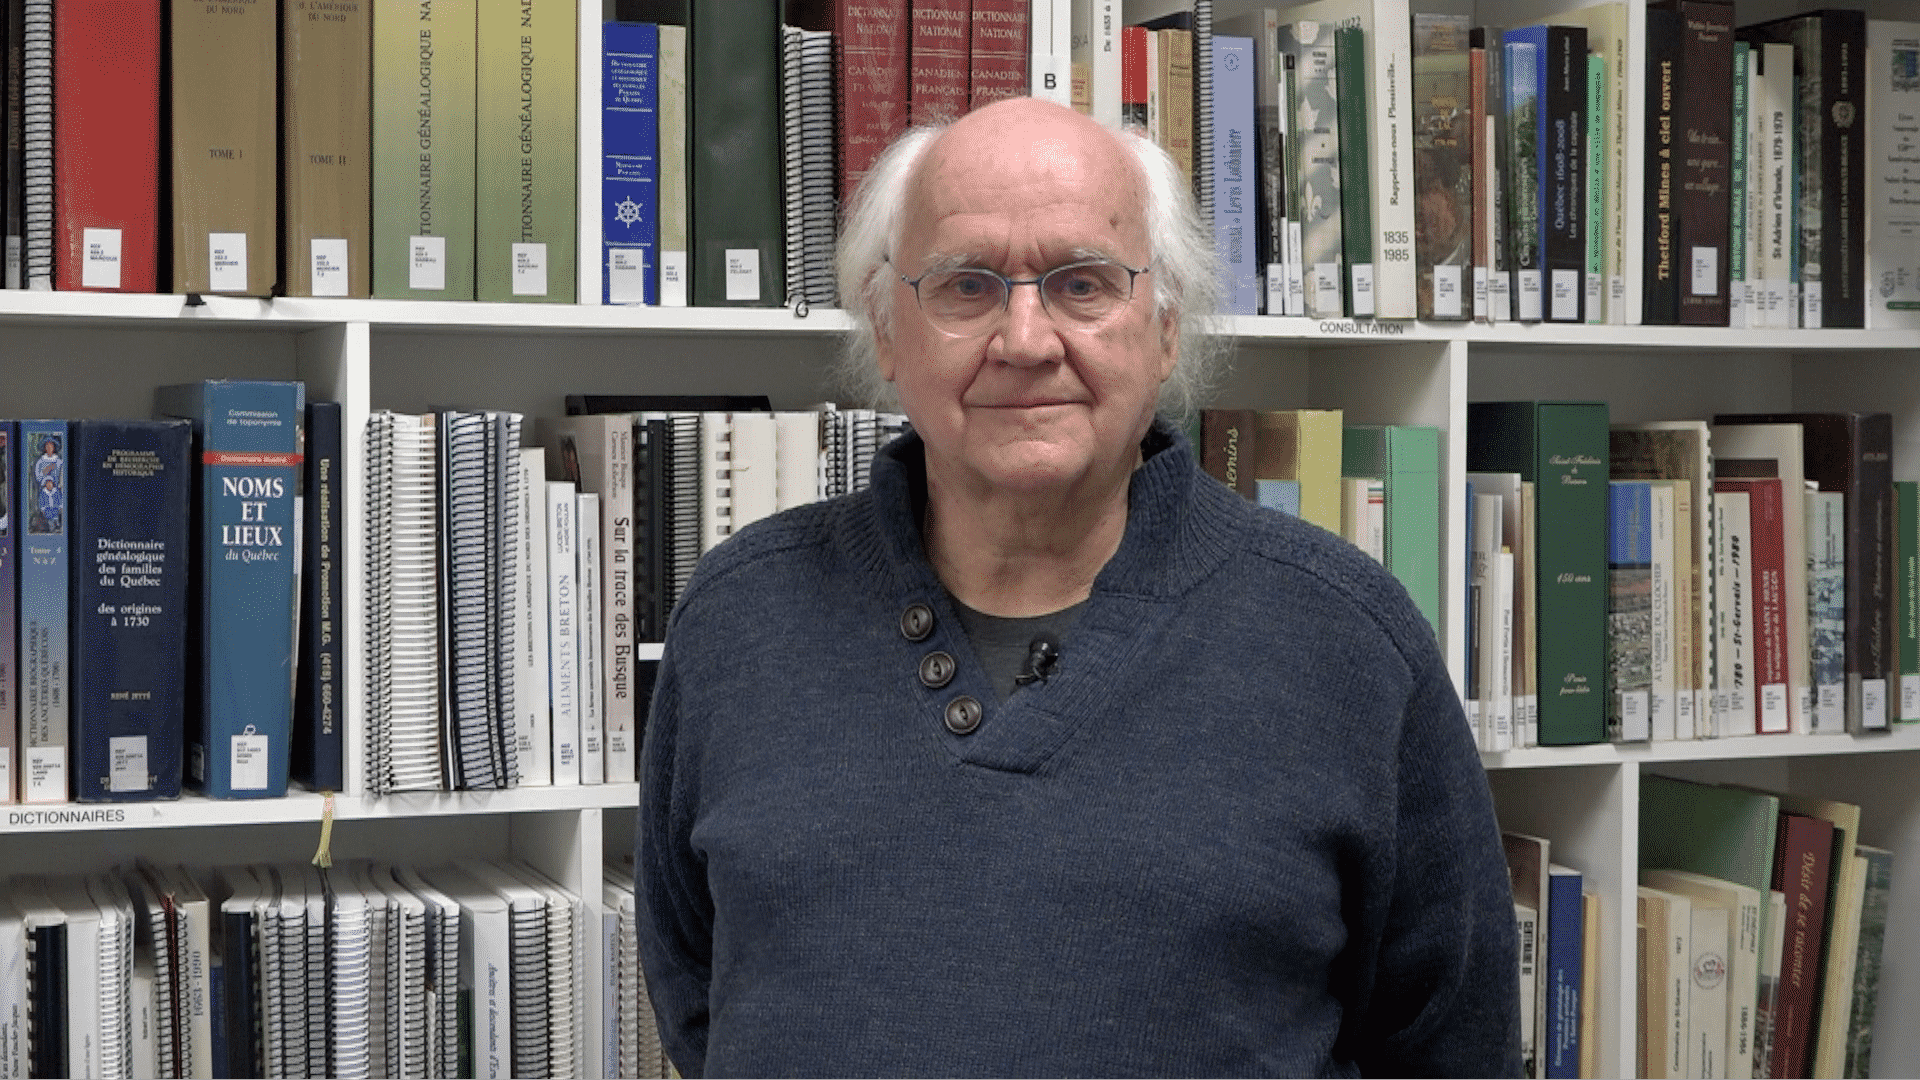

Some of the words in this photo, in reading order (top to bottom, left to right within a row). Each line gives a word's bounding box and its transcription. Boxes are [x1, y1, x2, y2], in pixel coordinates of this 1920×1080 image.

[920, 25, 963, 39] NATIONAL
[980, 27, 1023, 40] NATIONAL
[417, 29, 433, 150] GÉNÉALOGIQUE
[1044, 74, 1056, 89] B
[1660, 60, 1672, 112] ouvert
[518, 36, 534, 154] GÉNÉALOGIQUE
[1569, 111, 1579, 147] capitale
[1660, 116, 1672, 145] ciel
[1772, 111, 1783, 161] 1879-1979
[209, 149, 235, 159] TOME
[309, 155, 335, 165] TOME
[339, 155, 347, 166] II
[1554, 118, 1566, 181] 1608-2008
[1388, 124, 1400, 206] Rappelons-nous
[1569, 159, 1578, 170] de
[1658, 162, 1672, 209] Mines
[1554, 184, 1566, 229] Québec
[1569, 172, 1579, 222] chroniques
[1384, 232, 1408, 244] 1835
[1657, 213, 1671, 281] Thetford
[1384, 249, 1409, 261] 1985
[1319, 322, 1404, 335] CONSULTATION
[228, 409, 279, 419] Commission
[240, 419, 282, 427] toponymie
[111, 450, 155, 458] PROGRAMME
[619, 431, 627, 461] Maurice
[119, 456, 160, 464] RECHERCHE
[319, 458, 330, 480] Une
[113, 469, 155, 477] HISTORIQUE
[222, 477, 285, 498] NOMS
[241, 501, 268, 522] ET
[319, 484, 331, 542] réalisation
[222, 525, 283, 547] LIEUX
[614, 516, 630, 542] Sur
[98, 539, 165, 550] Dictionnaire
[319, 544, 331, 558] de
[1731, 535, 1741, 566] 1980
[96, 550, 165, 563] généalogique
[225, 549, 239, 561] du
[242, 549, 280, 564] Québec
[615, 549, 629, 563] la
[98, 563, 116, 575] des
[121, 563, 162, 575] familles
[1557, 572, 1574, 583] 150
[1574, 575, 1591, 583] ans
[100, 575, 114, 587] du
[120, 575, 161, 588] Québec
[320, 562, 332, 618] Promotion
[615, 569, 629, 606] trace
[1653, 563, 1662, 610] CLOCHER
[98, 603, 115, 615] des
[120, 604, 162, 616] origines
[558, 575, 570, 637] BRETON
[1732, 581, 1742, 646] St-Gervais
[111, 616, 117, 627] à
[124, 616, 149, 627] 1730
[614, 612, 630, 638] des
[1653, 611, 1662, 627] DU
[321, 620, 332, 646] M.G.
[1653, 631, 1662, 673] L'OMBRE
[559, 641, 571, 717] ALIMENTS
[613, 644, 631, 699] Busque
[1733, 663, 1743, 689] 780
[321, 683, 332, 735] 660-4274
[41, 725, 50, 743] DES
[9, 810, 125, 825] DICTIONNAIRES
[1801, 851, 1816, 892] Désir
[1798, 893, 1814, 911] de
[1796, 912, 1808, 927] se
[1791, 930, 1807, 989] raconter
